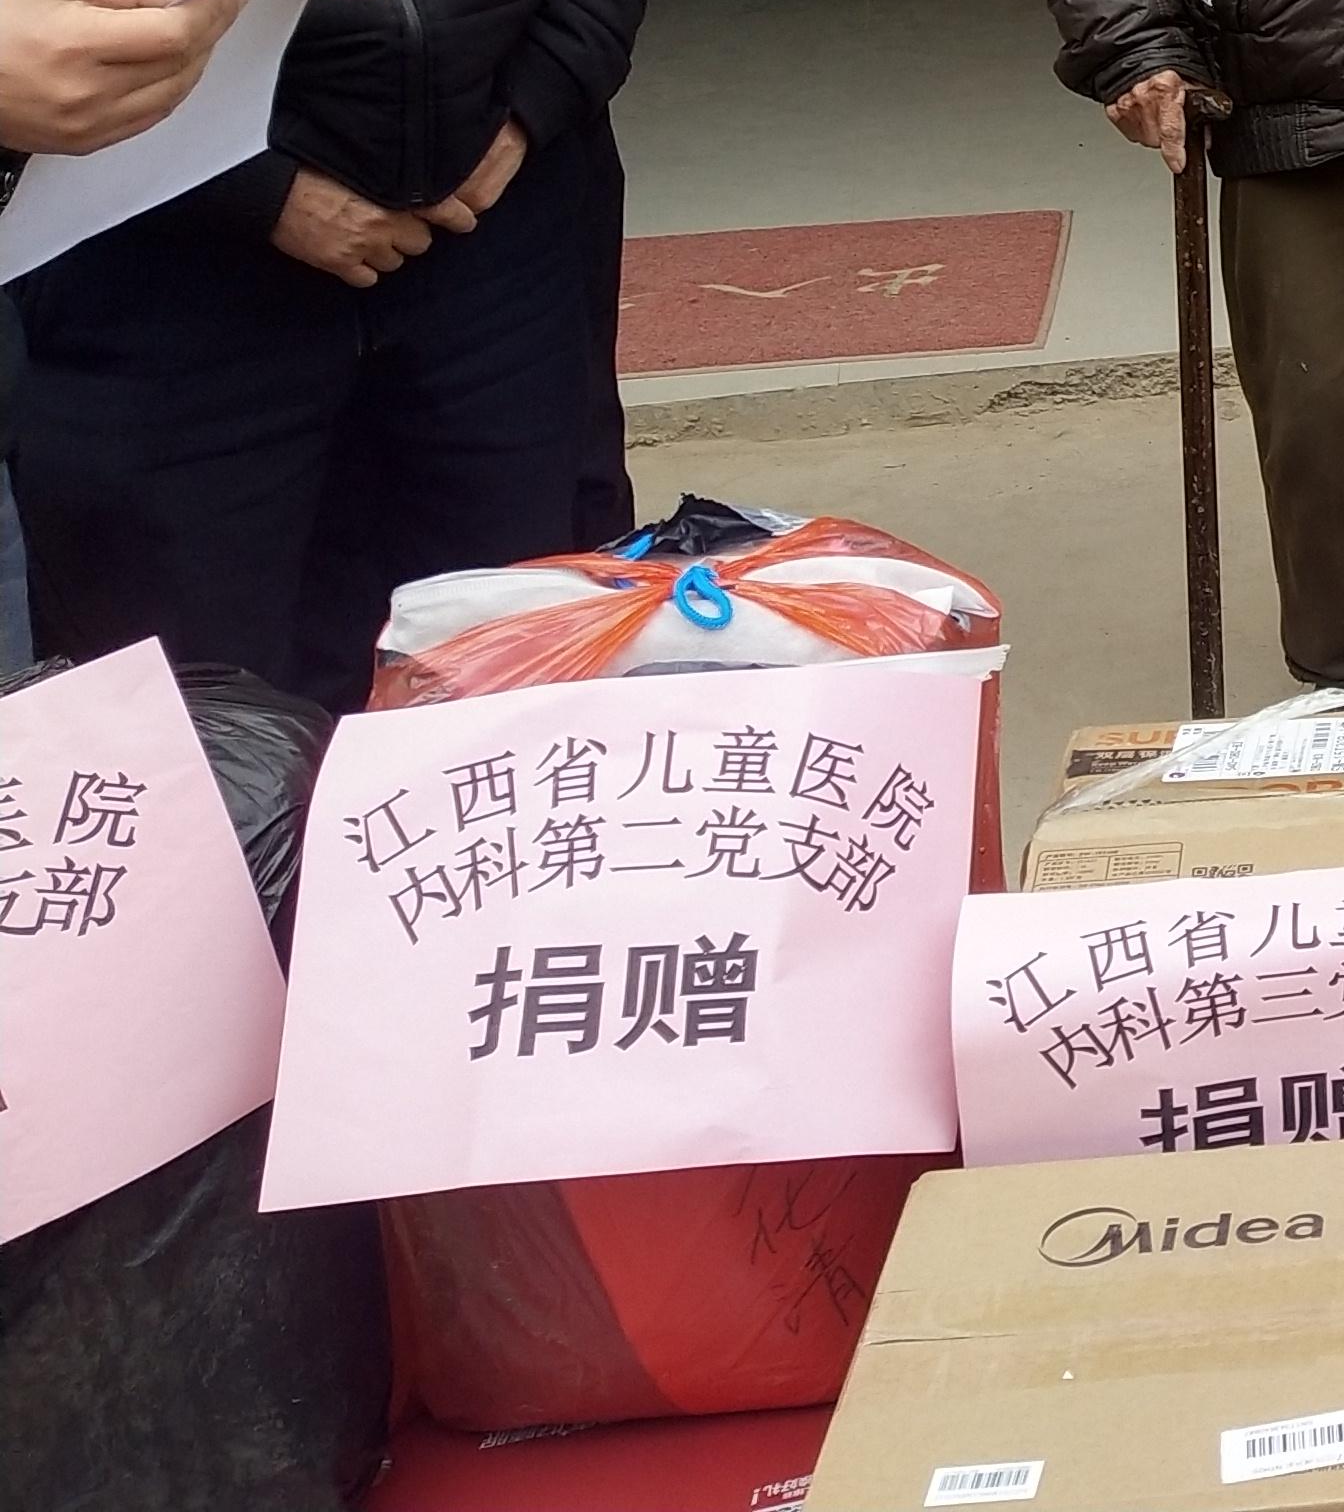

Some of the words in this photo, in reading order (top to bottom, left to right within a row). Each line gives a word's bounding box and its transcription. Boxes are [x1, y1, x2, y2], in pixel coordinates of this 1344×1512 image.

[343, 724, 936, 873] 江西省儿童医院
[388, 804, 897, 944] 内科第二党支部
[467, 932, 760, 1061] 捐赠
[1055, 1207, 1325, 1264] Midea
